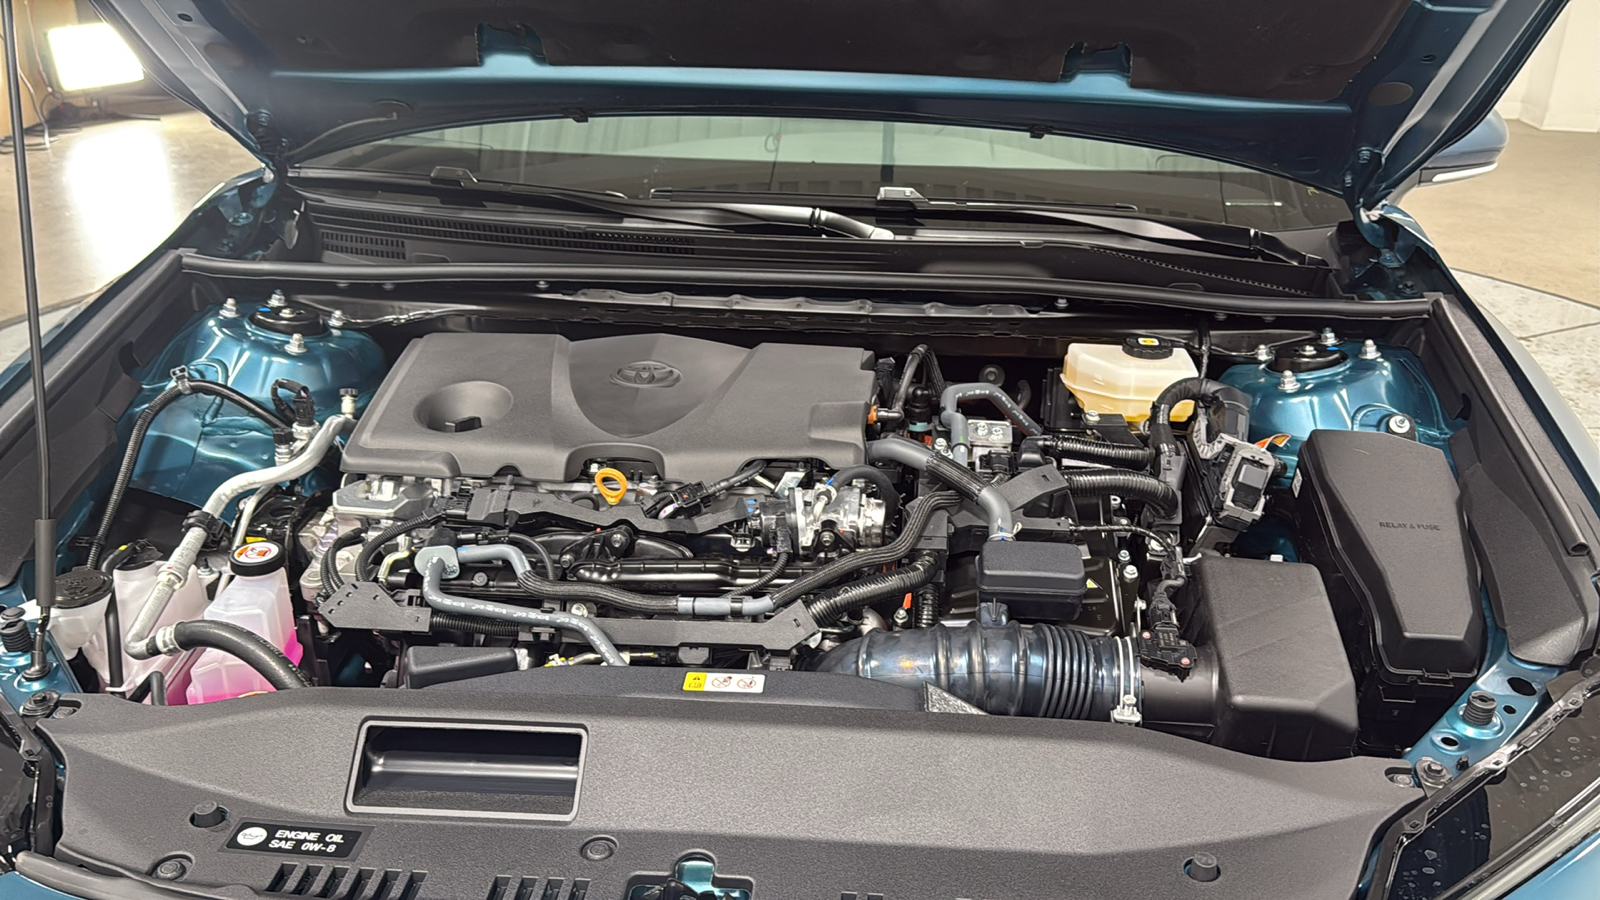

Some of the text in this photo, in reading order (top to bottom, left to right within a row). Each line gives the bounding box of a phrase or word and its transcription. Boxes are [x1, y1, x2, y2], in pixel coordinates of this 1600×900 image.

[1379, 521, 1408, 529] RELAY
[1416, 523, 1441, 531] FUSE
[275, 829, 345, 843] ENGINE OIL
[268, 840, 337, 853] SAE 0W-8
